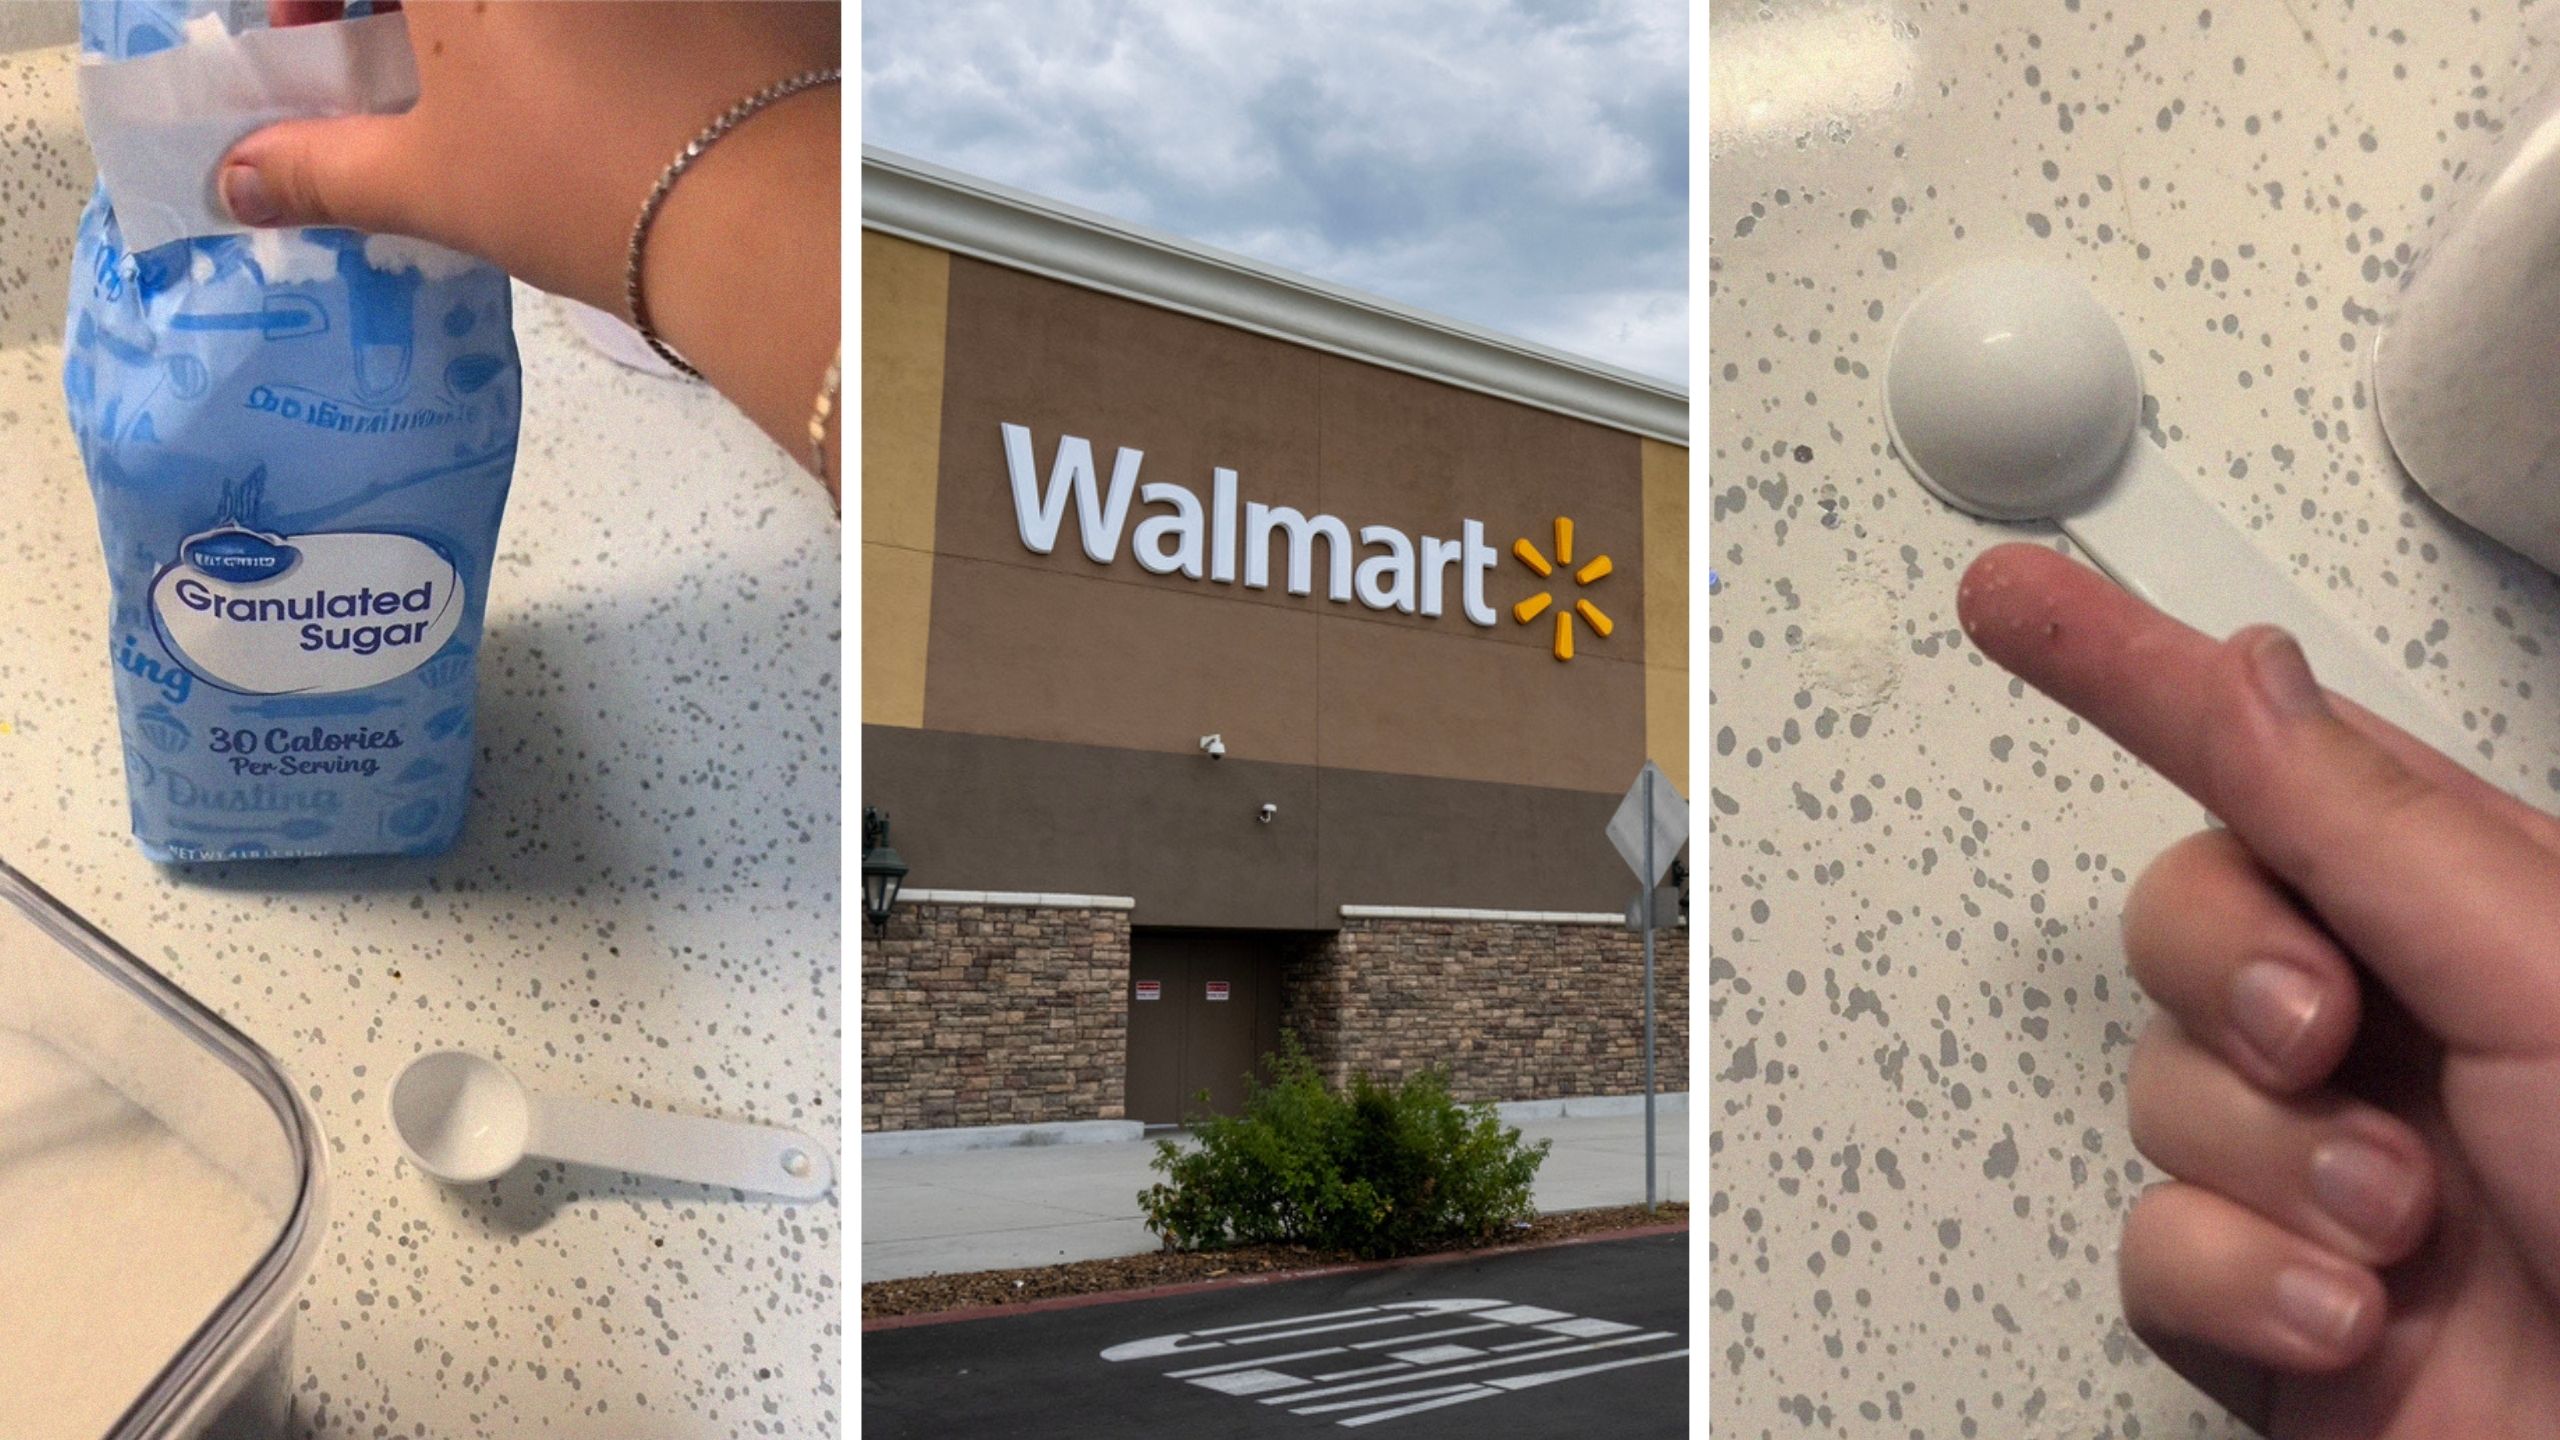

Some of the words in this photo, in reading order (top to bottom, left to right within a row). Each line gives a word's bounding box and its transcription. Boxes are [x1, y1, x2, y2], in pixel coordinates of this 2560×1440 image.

[1001, 422, 1498, 627] Walmart
[175, 579, 433, 622] Granulated
[300, 619, 430, 656] Sugar
[209, 727, 258, 755] 30
[264, 725, 404, 755] Calories
[229, 756, 277, 777] Per
[278, 753, 381, 777] Serving
